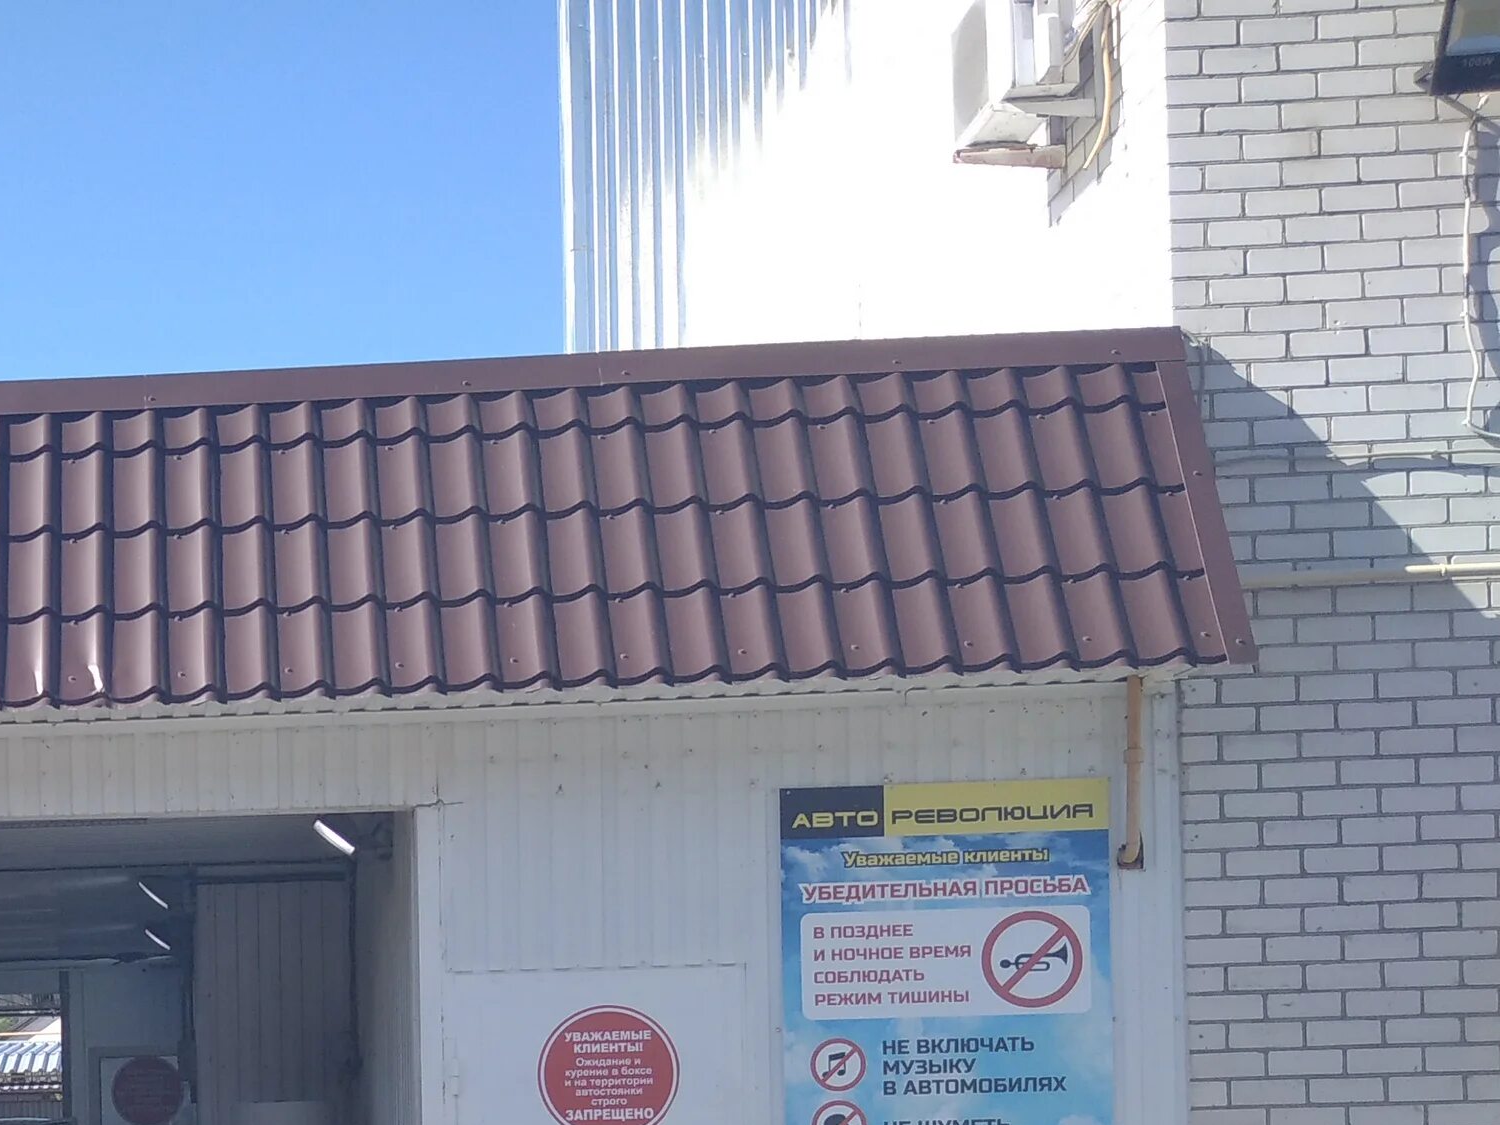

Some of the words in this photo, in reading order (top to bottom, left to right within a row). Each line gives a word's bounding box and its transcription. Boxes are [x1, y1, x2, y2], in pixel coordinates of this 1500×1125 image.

[792, 810, 878, 828] АВТО
[891, 803, 1093, 824] РЕВОЛЮЦИЯ
[842, 851, 960, 869] Уважаемые
[963, 848, 1049, 864] клиенты
[802, 881, 978, 903] УБЕДИТЕЛЬНАЯ
[984, 876, 1089, 897] ПРОСЬБА
[813, 926, 824, 939] В
[830, 923, 913, 940] ПОЗДНЕЕ
[813, 948, 825, 961] И
[831, 946, 903, 961] НОЧНОЕ
[909, 944, 971, 959] ВРЕМЯ
[813, 968, 924, 985] СОБЛЮДАТЬ
[814, 991, 881, 1006] РЕЖИМ
[887, 989, 969, 1004] ТИШИНЫ
[564, 1029, 651, 1042] УВАЖАЕМЫЕ
[573, 1042, 643, 1053] КЛИЕНТЫ!
[882, 1038, 909, 1055] НЕ
[916, 1035, 1034, 1054] ВКЛЮЧАТЬ
[575, 1057, 631, 1067] Ожидание
[634, 1057, 641, 1065] и
[882, 1057, 976, 1075] МУЗЫКУ
[564, 1068, 608, 1079] курение
[611, 1067, 618, 1076] в
[620, 1066, 652, 1075] боксе
[573, 1078, 587, 1086] на
[589, 1076, 653, 1088] территории
[883, 1080, 896, 1095] В
[903, 1076, 1066, 1095] АВТОМОБИЛЯХ
[575, 1087, 642, 1096] автостоянки
[590, 1097, 627, 1107] строго
[565, 1107, 654, 1122] ЗАПРЕЩЕНО
